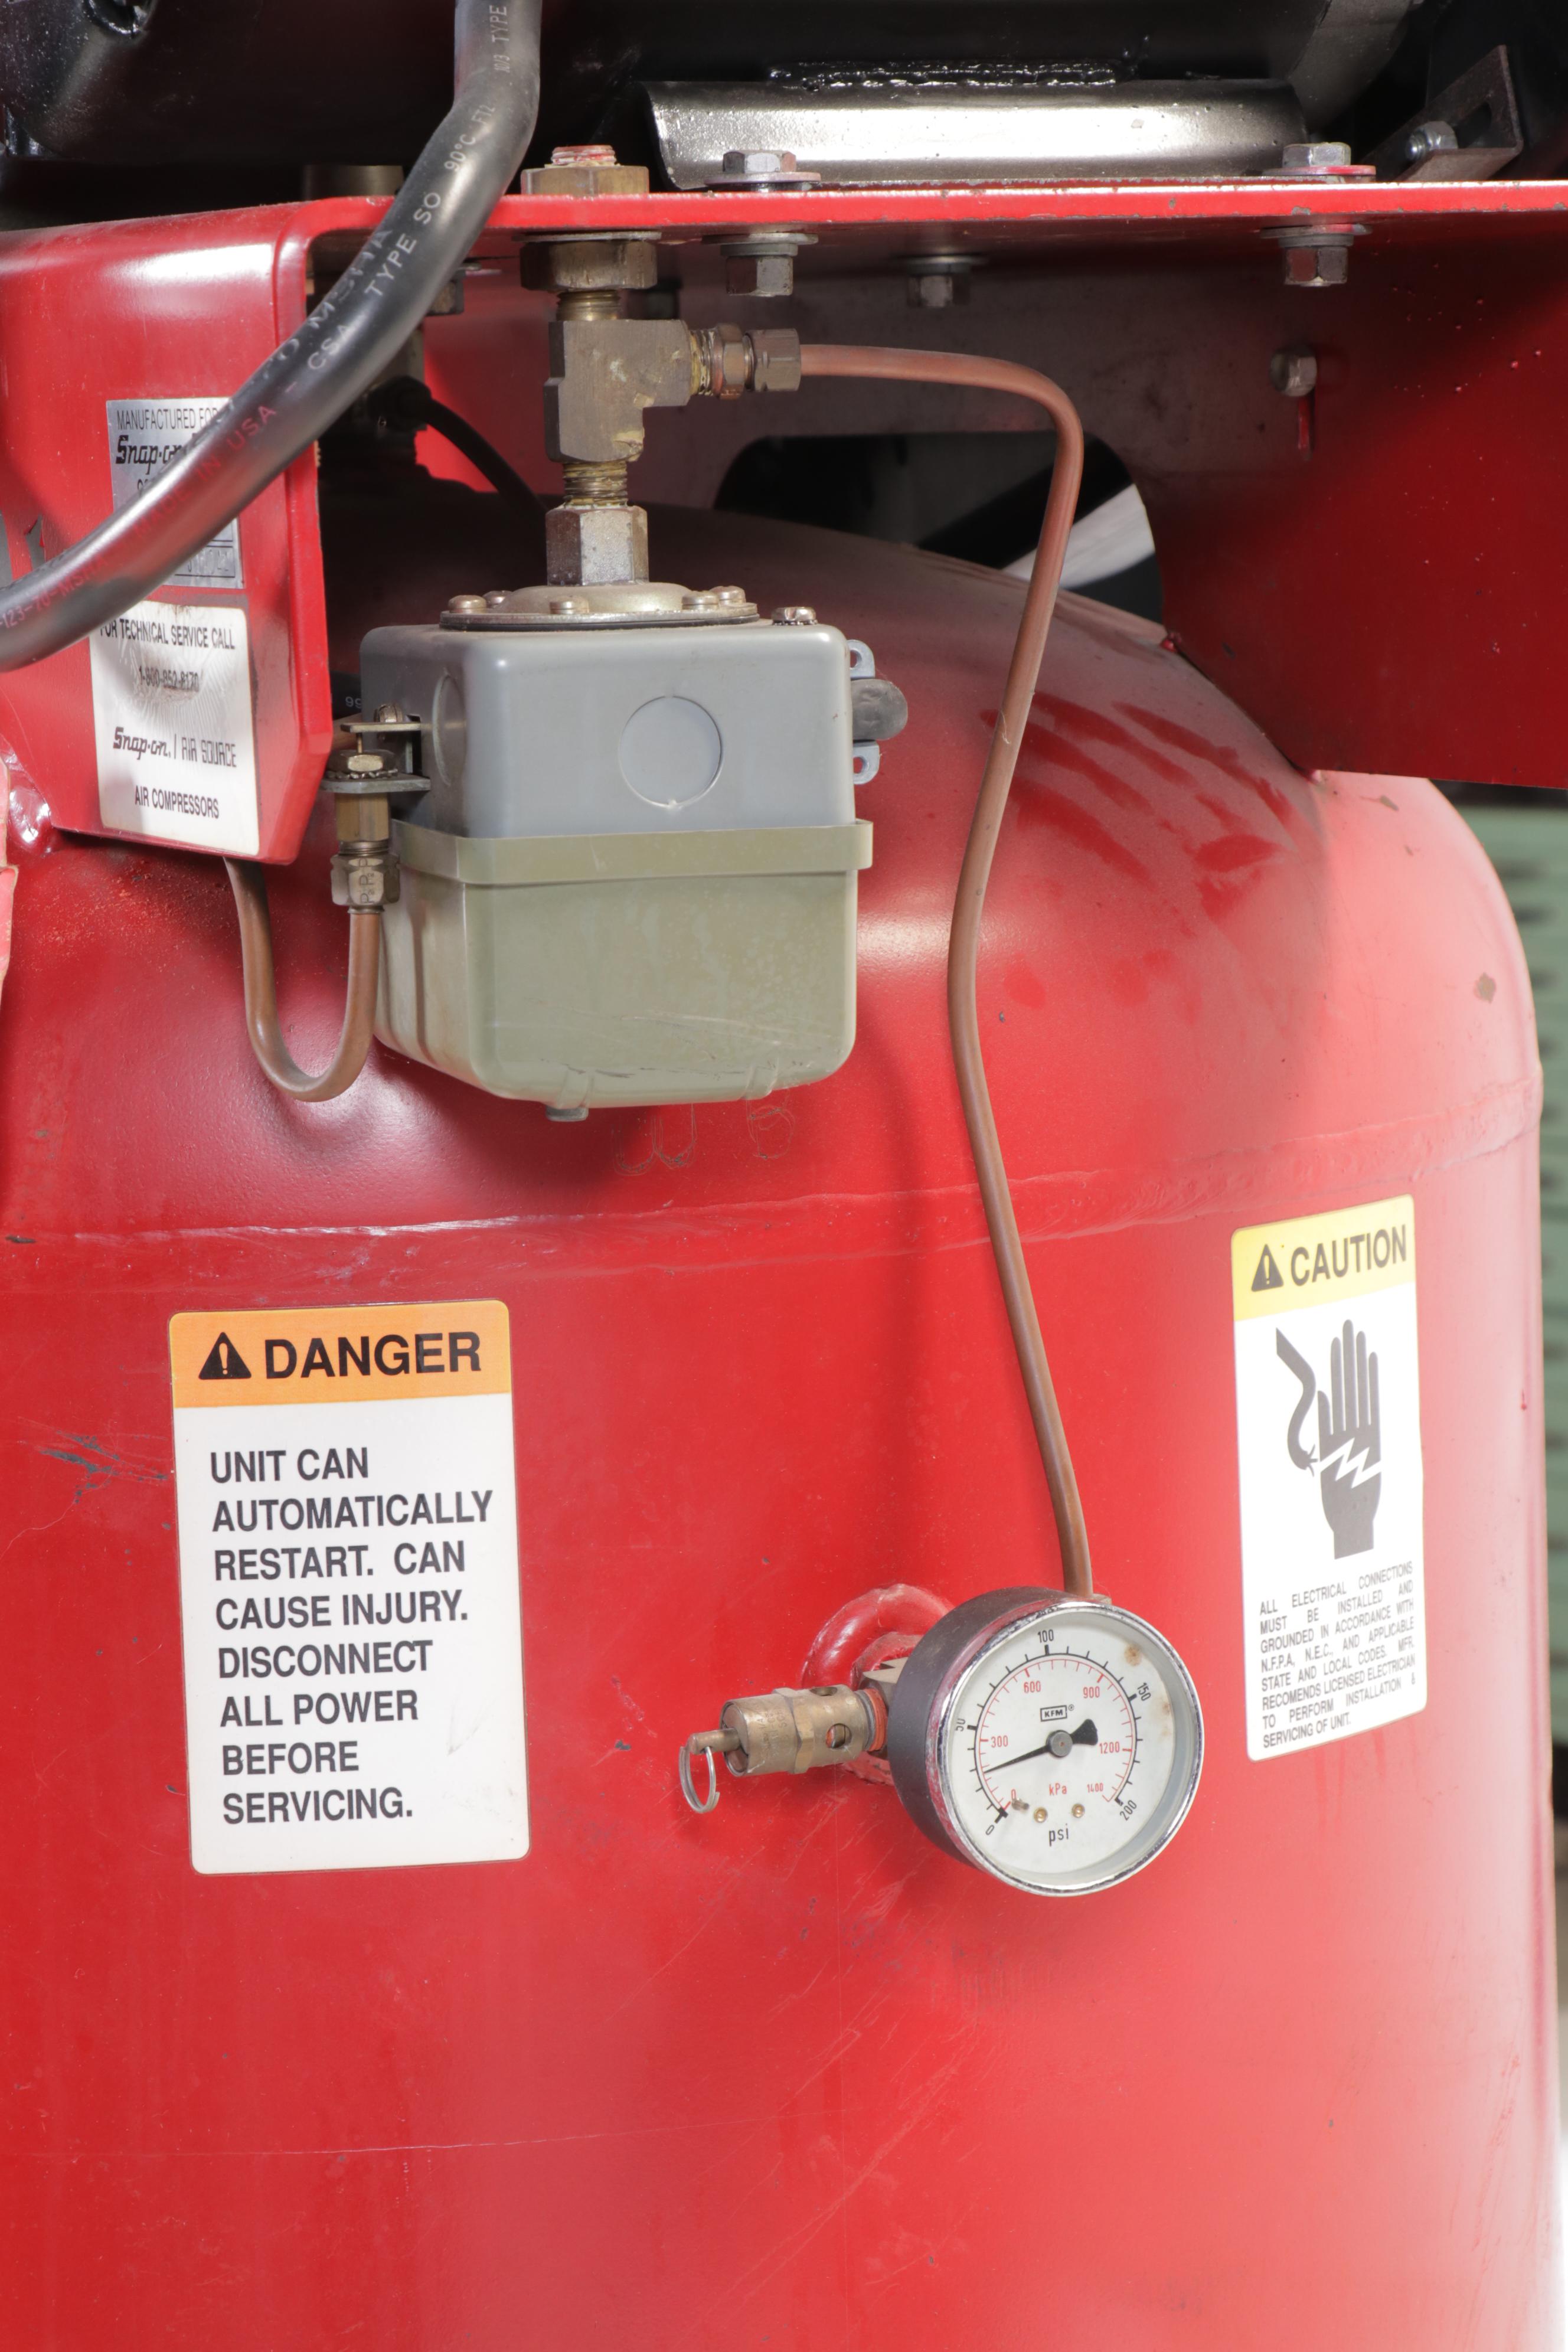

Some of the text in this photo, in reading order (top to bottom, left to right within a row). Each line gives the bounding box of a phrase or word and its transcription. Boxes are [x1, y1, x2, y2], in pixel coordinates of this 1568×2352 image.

[227, 405, 277, 450] USA
[308, 324, 348, 369] CSA
[364, 233, 416, 295] TYPE
[414, 192, 440, 224] SO
[444, 134, 476, 171] 90°C
[489, 5, 509, 43] TYPE
[117, 408, 196, 430] MANUFACTURED
[119, 618, 169, 645] TECHNICAL
[171, 625, 208, 648] SERVICE
[211, 628, 236, 649] CALL
[182, 737, 197, 762] AIR
[201, 740, 237, 767] SOURCE
[135, 785, 219, 819] AIR COMPRESSORS
[1291, 1224, 1407, 1287] CAUTION
[264, 1331, 482, 1379] DANGER
[210, 1446, 369, 1484] UNIT CAN
[212, 1489, 493, 1533] AUTOMATICALLY
[214, 1540, 466, 1581] RESTART. CAN
[1260, 1561, 1413, 1615] ALL ELECTRICAL CONNECTIONS
[215, 1589, 468, 1631] CAUSE INJURY.
[1260, 1580, 1413, 1635] MUST BE INSTALLED AND
[1037, 1629, 1054, 1644] 100
[1260, 1598, 1414, 1653] GROUNDED IN ACCORDANCE WITH
[1342, 1634, 1360, 1651] AND
[1368, 1616, 1414, 1644] APPLICABLE
[218, 1639, 433, 1679] DISCONNECT
[1262, 1635, 1415, 1692] STATE AND LOCAL CODES. MFR.
[1023, 1681, 1041, 1693] 600
[1083, 1686, 1100, 1699] 900
[1136, 1682, 1151, 1702] 150
[1262, 1653, 1415, 1711] RECOMENDS LICENSED ELECTRICIAN
[220, 1689, 419, 1727] ALL POWER
[1044, 1709, 1063, 1719] KFM
[1262, 1714, 1276, 1729] TO
[1289, 1698, 1334, 1723] PERFORM
[1345, 1677, 1402, 1707] INSTALLATION
[991, 1735, 1008, 1748] 300
[1263, 1712, 1351, 1749] SERVICING OF UNIT.
[221, 1741, 359, 1776] BEFORE
[1099, 1742, 1120, 1755] 1200
[1011, 1789, 1017, 1801] 0
[1048, 1782, 1067, 1796] kPa
[1087, 1783, 1103, 1793] 1400
[223, 1787, 413, 1825] SERVICING.
[1119, 1799, 1137, 1821] 200
[985, 1824, 995, 1836] 0
[1048, 1824, 1069, 1847] psi
